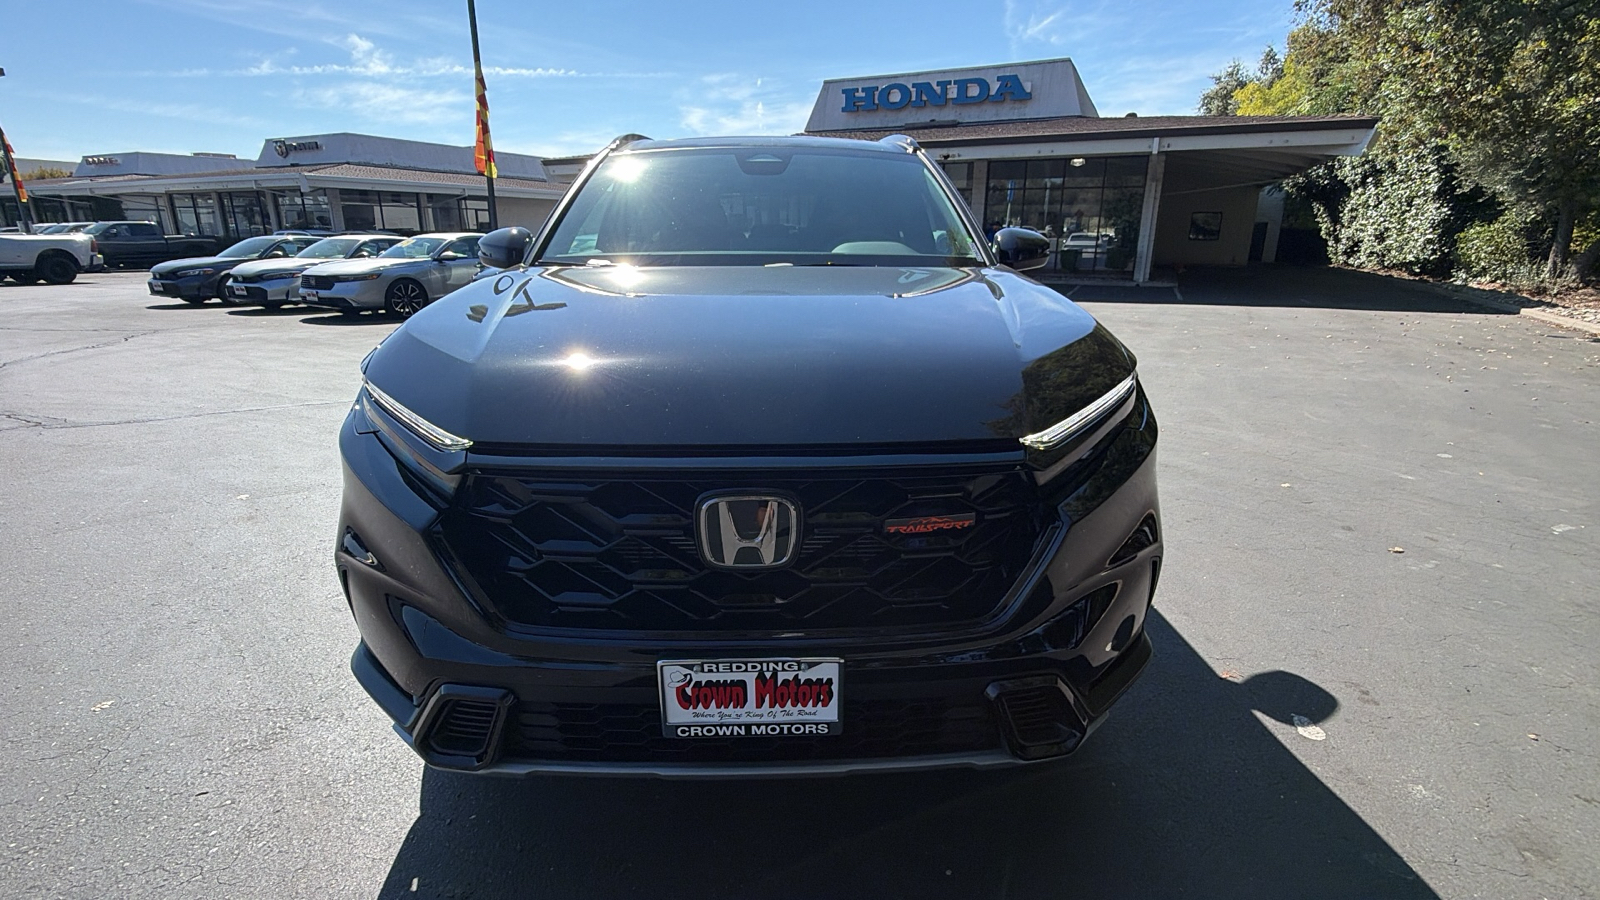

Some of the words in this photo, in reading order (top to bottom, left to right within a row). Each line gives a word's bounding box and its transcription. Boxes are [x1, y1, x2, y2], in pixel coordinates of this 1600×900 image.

[841, 74, 1032, 113] HONDA
[886, 519, 974, 533] TRAILSPORT
[703, 662, 799, 673] REDDING
[675, 674, 748, 710] Crown
[755, 672, 834, 709] Motors
[691, 711, 716, 719] Where
[717, 710, 743, 720] You're
[744, 711, 765, 719] King
[766, 710, 778, 719] Of
[779, 709, 794, 717] The
[796, 709, 819, 717] Road
[676, 725, 746, 737] CROWN
[751, 723, 829, 736] MOTORS
